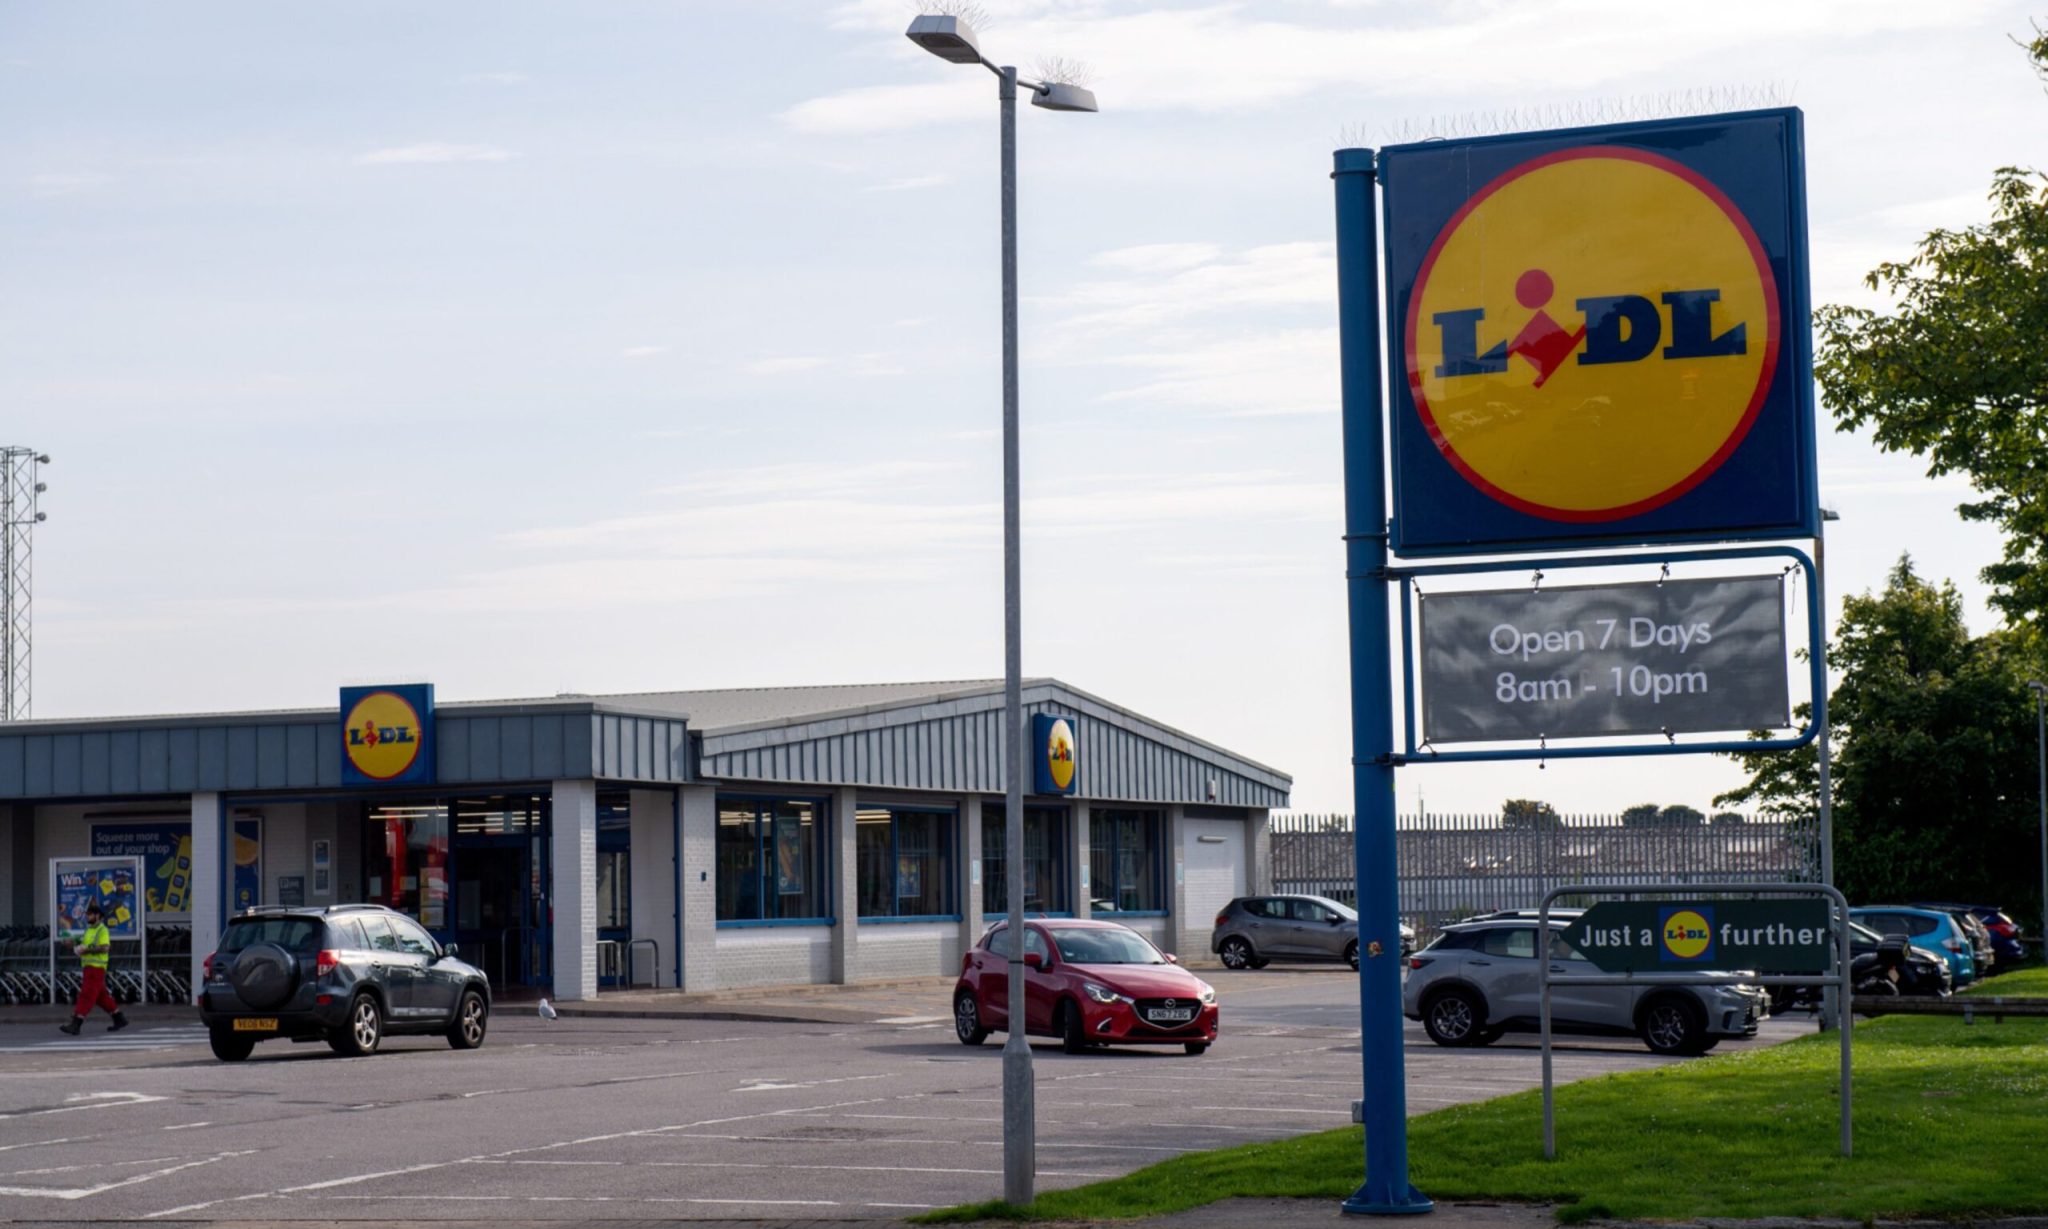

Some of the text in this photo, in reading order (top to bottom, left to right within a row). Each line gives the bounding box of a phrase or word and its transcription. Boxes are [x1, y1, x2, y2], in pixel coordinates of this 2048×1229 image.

[1489, 617, 1712, 662] Open 7 Days
[1495, 671, 1572, 703] 8am
[1611, 665, 1708, 704] 10pm
[96, 832, 160, 845] Squeeze more
[96, 843, 170, 856] out of your shop
[61, 873, 82, 887] Win
[1580, 925, 1632, 947] Just
[1640, 928, 1653, 947] a
[1720, 923, 1826, 946] further
